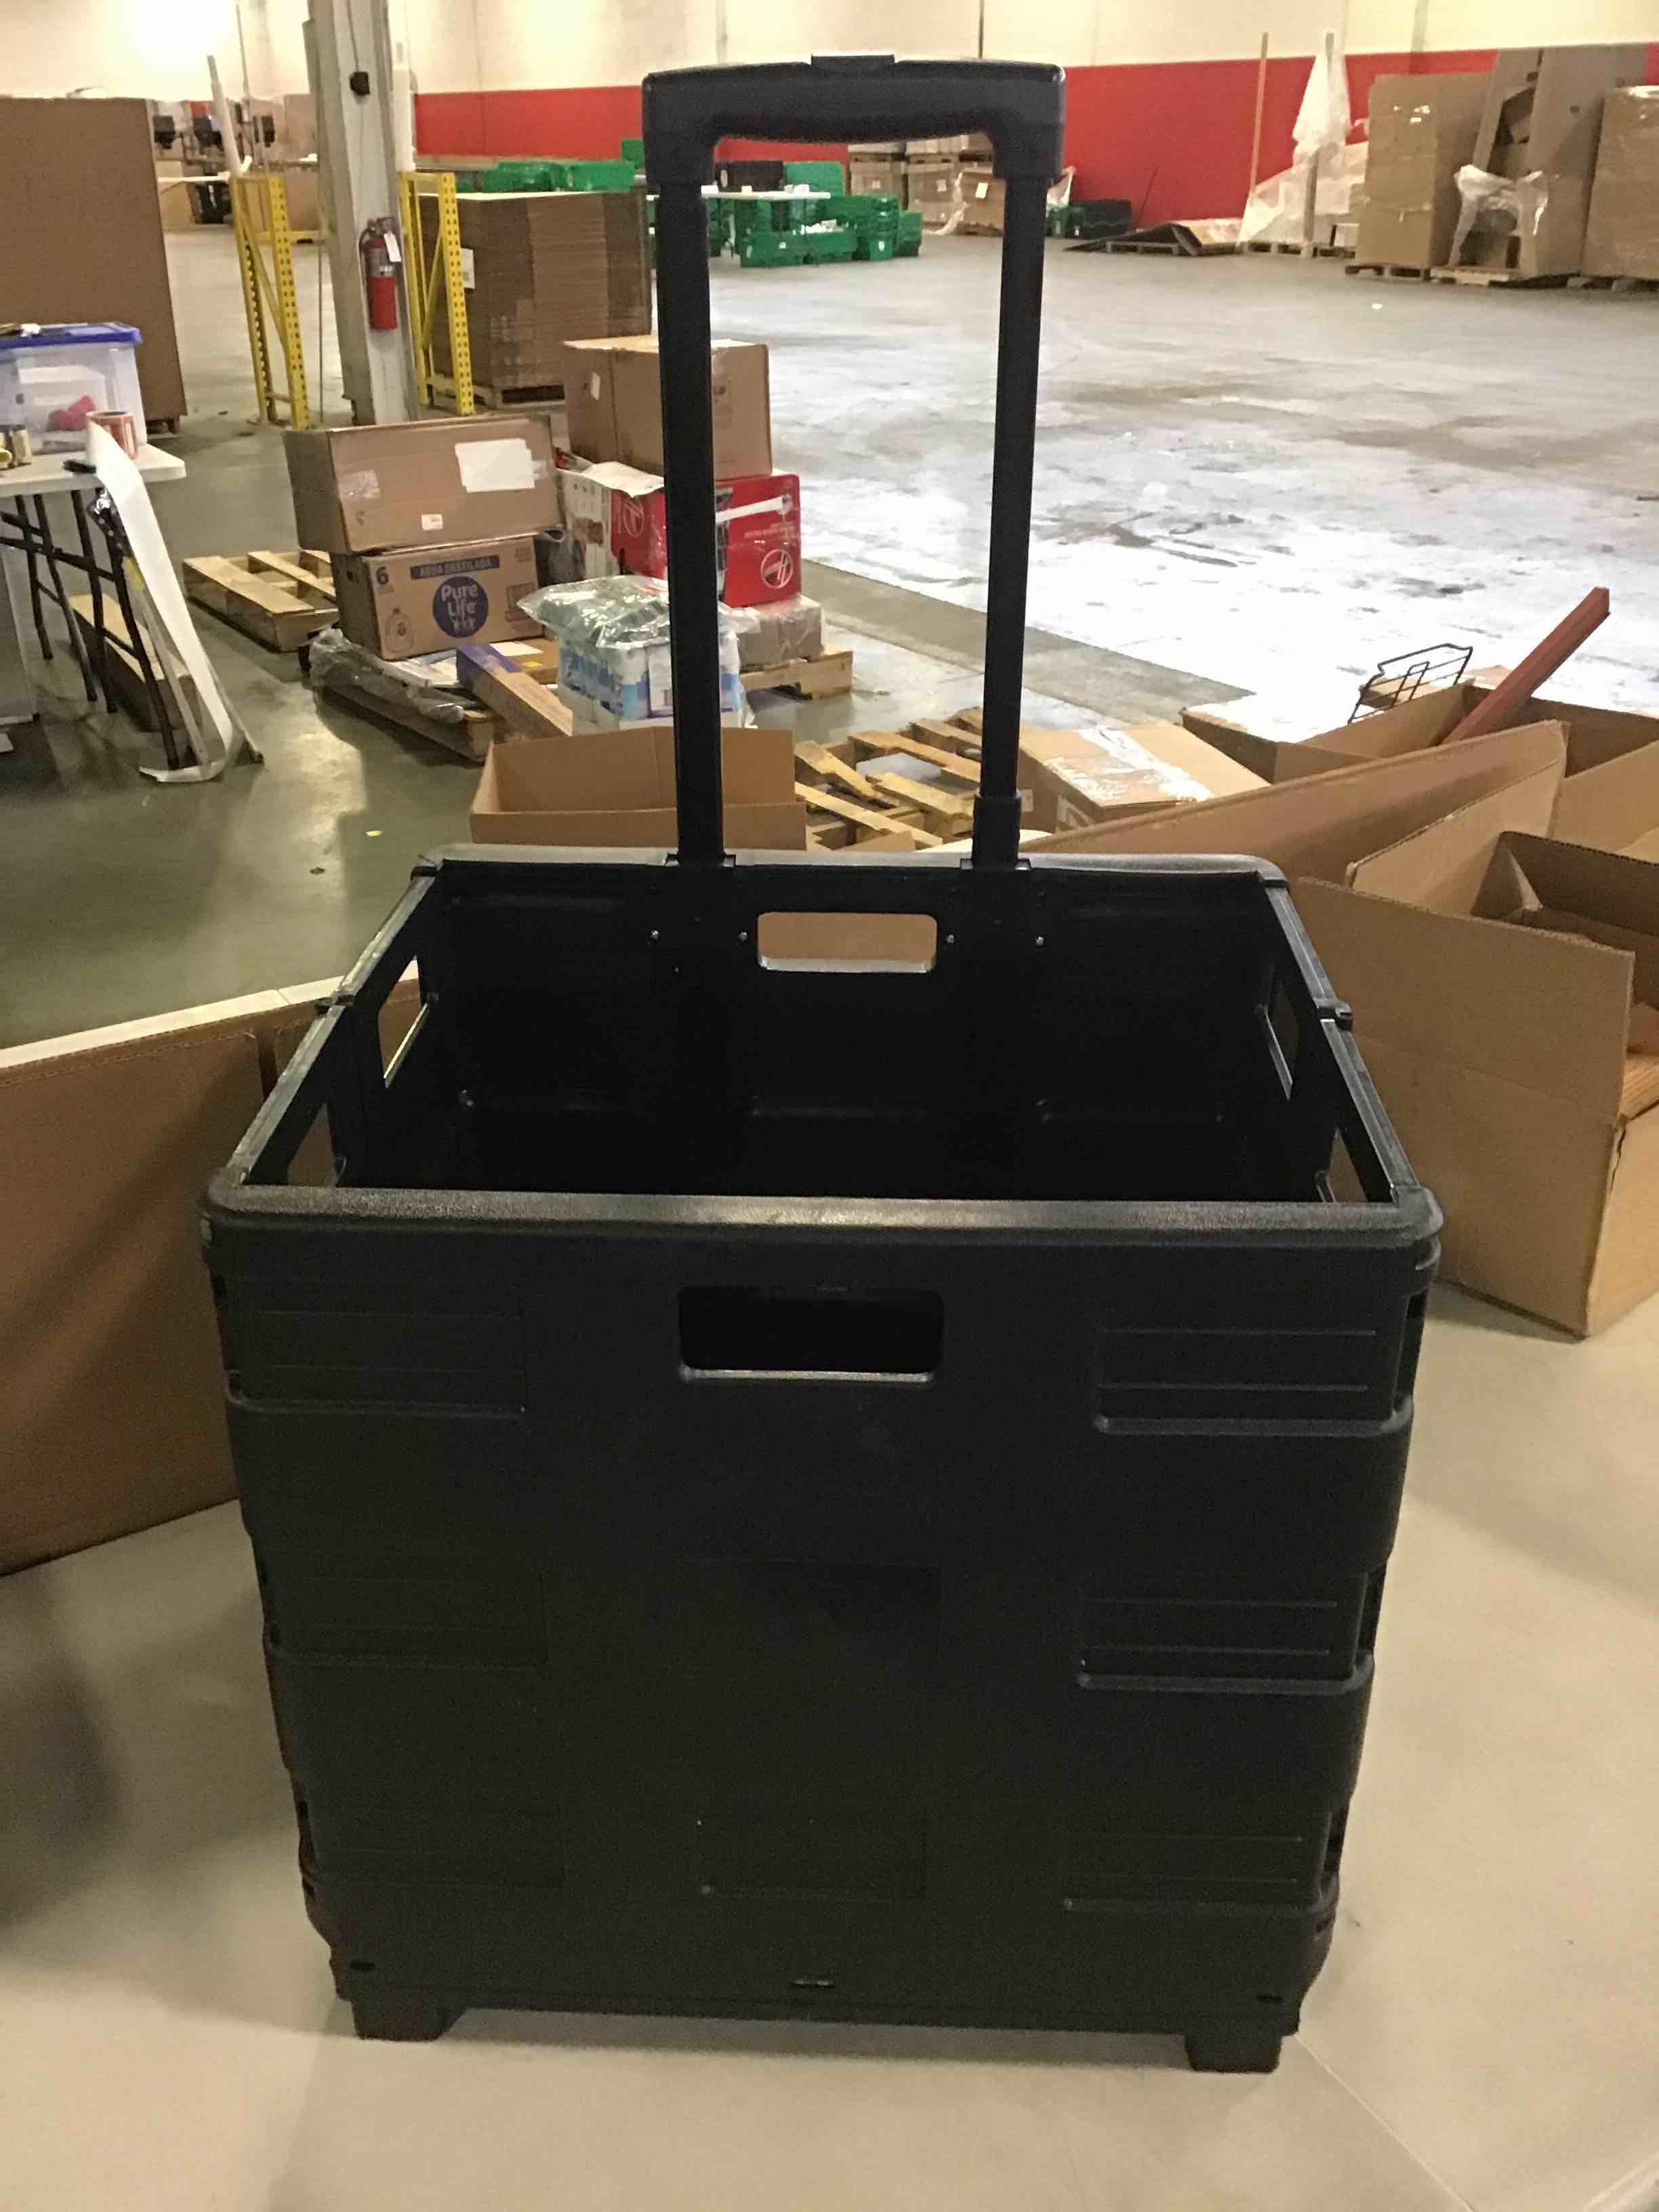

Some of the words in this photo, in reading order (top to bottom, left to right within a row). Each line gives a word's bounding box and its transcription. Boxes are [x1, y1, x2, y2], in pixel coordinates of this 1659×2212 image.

[376, 567, 390, 585] 6
[441, 584, 478, 602] Pure
[448, 599, 477, 618] Life
